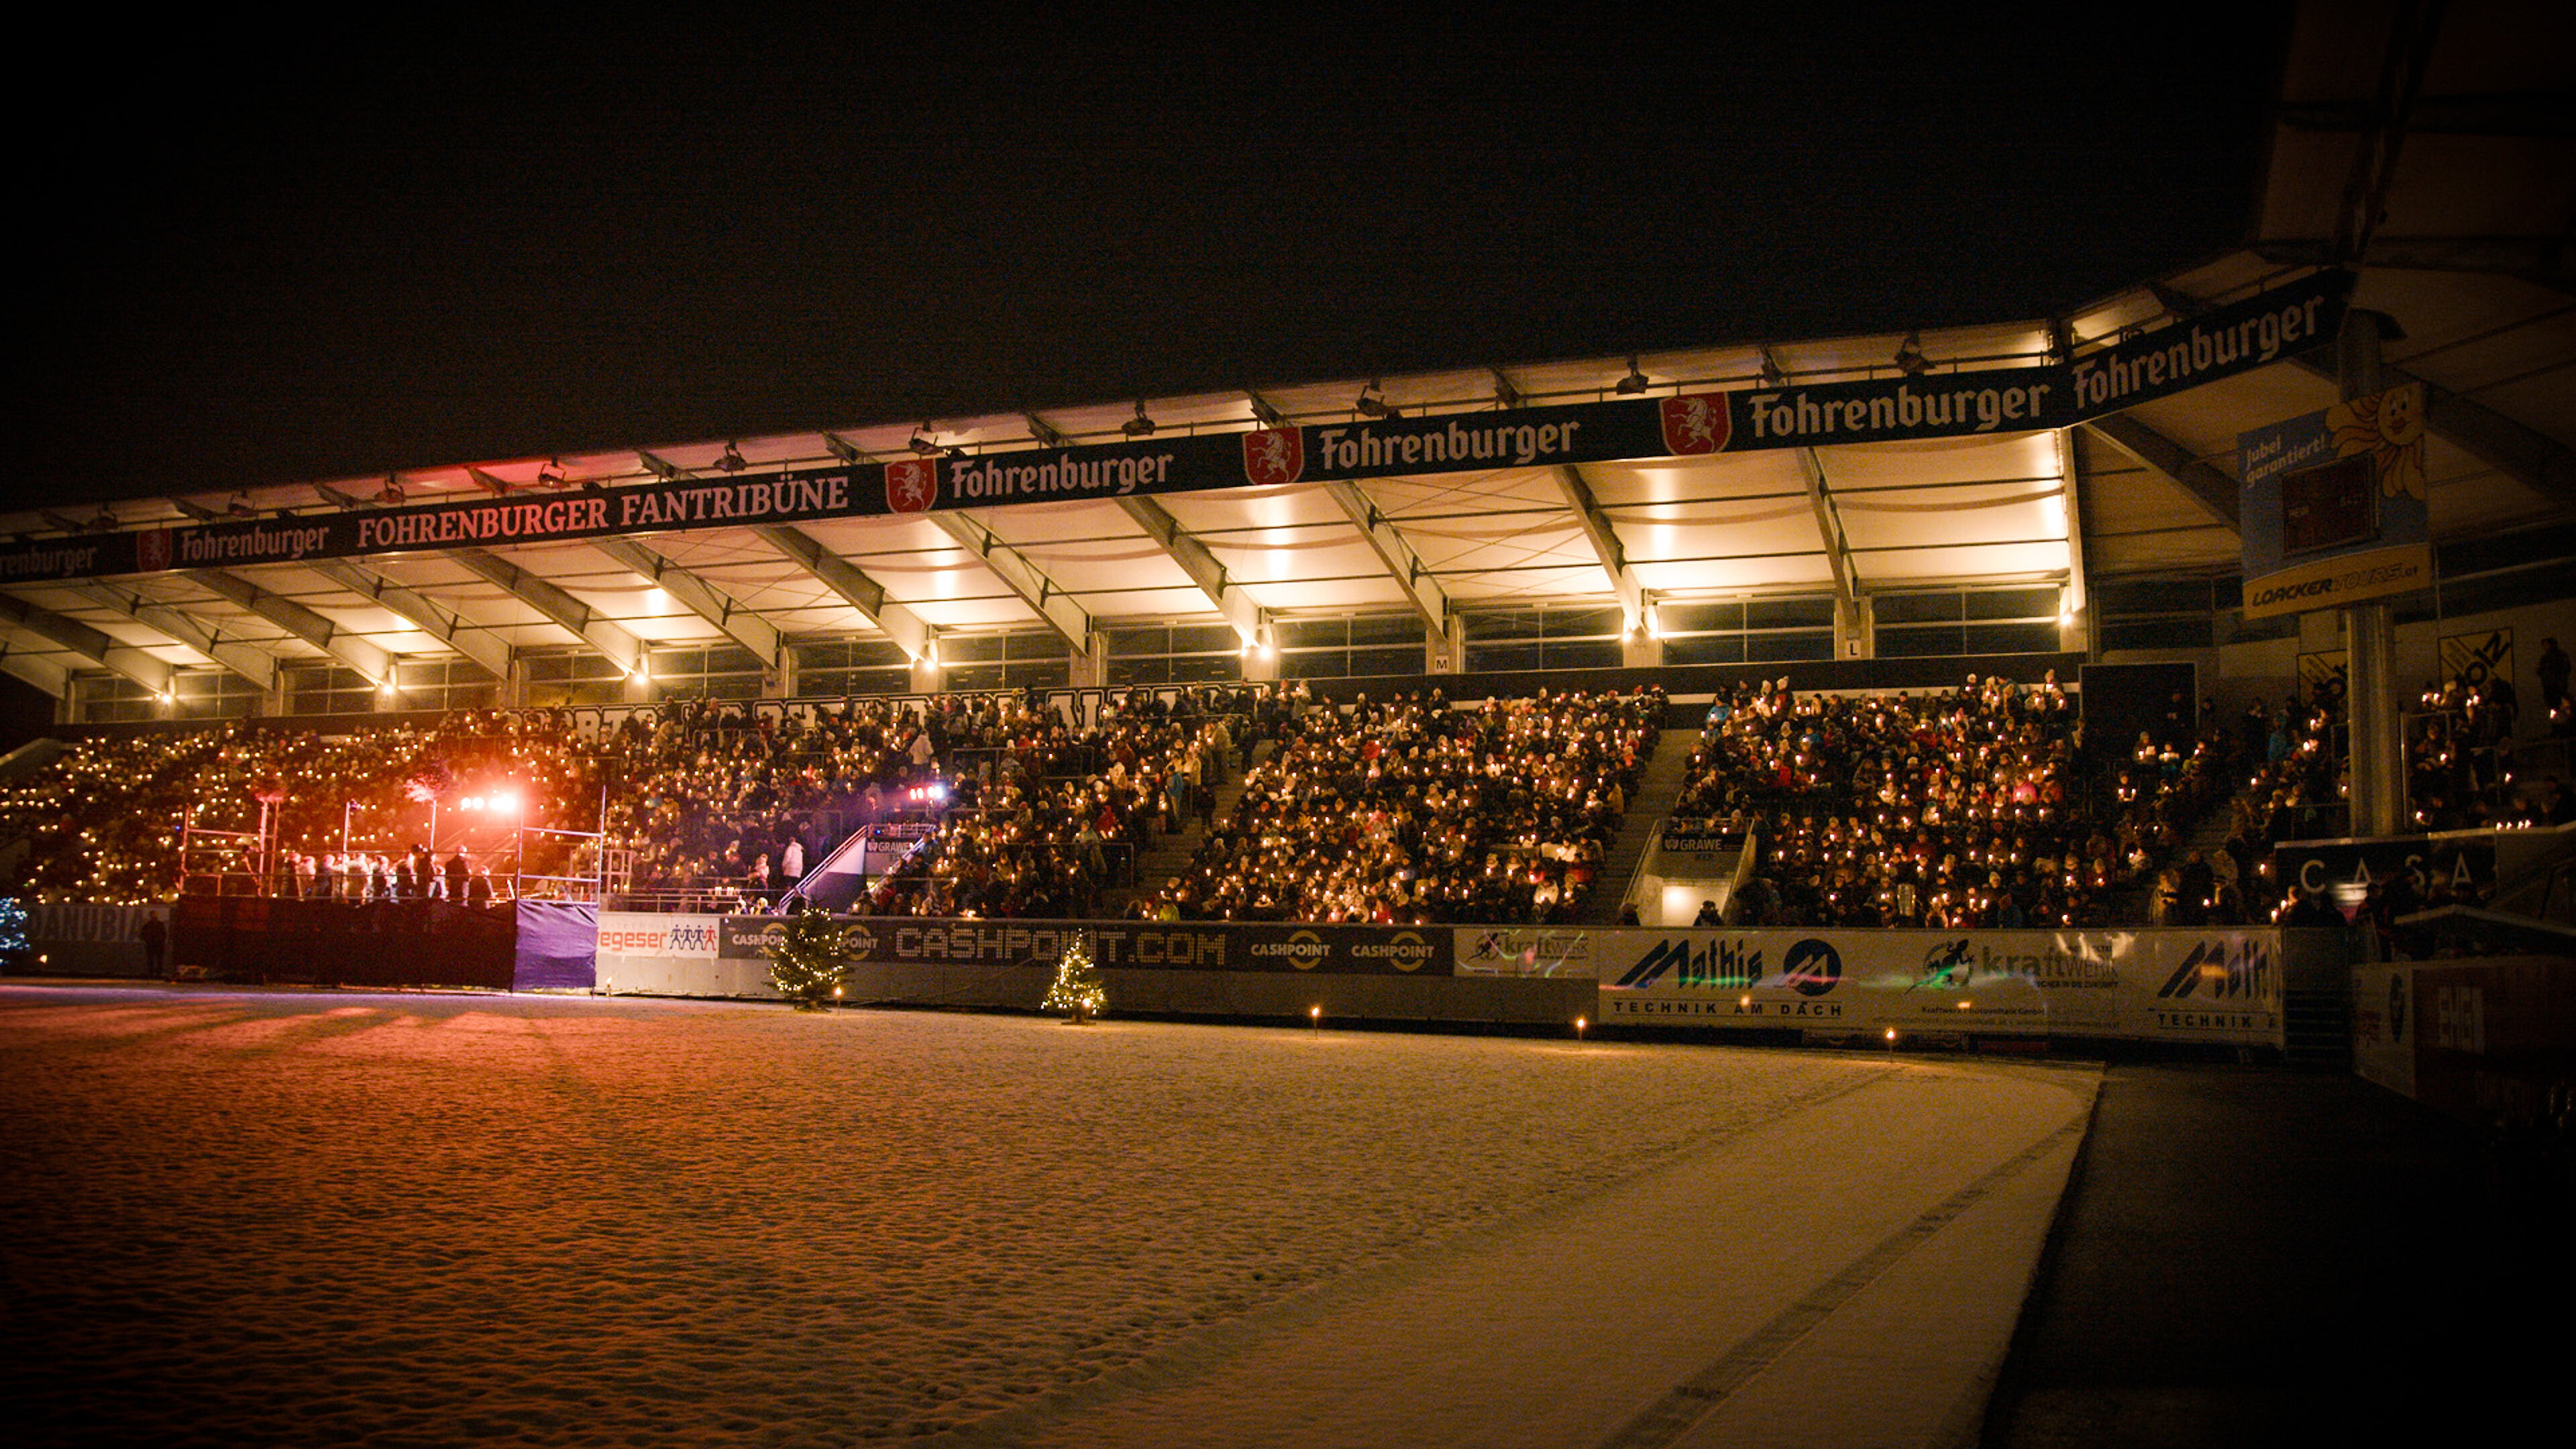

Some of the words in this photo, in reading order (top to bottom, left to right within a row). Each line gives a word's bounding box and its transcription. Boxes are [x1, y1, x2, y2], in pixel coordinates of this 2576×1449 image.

[2071, 292, 2326, 412] Fohrenburger
[1749, 380, 2051, 439] Fohrenburger
[1320, 418, 1580, 470] Fohrenburger
[2246, 434, 2281, 470] Jubel
[2246, 433, 2326, 488] garantiert!
[950, 451, 1175, 500] Fohrenburger
[358, 496, 609, 549] FOHRENBURGER
[621, 473, 849, 527] FANTRIBÜNE
[182, 525, 329, 561] Fohrenburger
[1436, 659, 1447, 669] M
[1850, 643, 1858, 655] L
[1680, 839, 1723, 851] GRAWE
[597, 932, 667, 951] egeser
[896, 927, 1226, 965] CASHPOINT.COM
[1250, 943, 1331, 959] CASHPOINT
[1351, 944, 1434, 960] CASHPOINT
[1615, 939, 1762, 989] Mathis
[1614, 1002, 1717, 1014] TECHNIK
[1735, 1004, 1763, 1015] AM
[2158, 1014, 2251, 1028] TECHNIK
